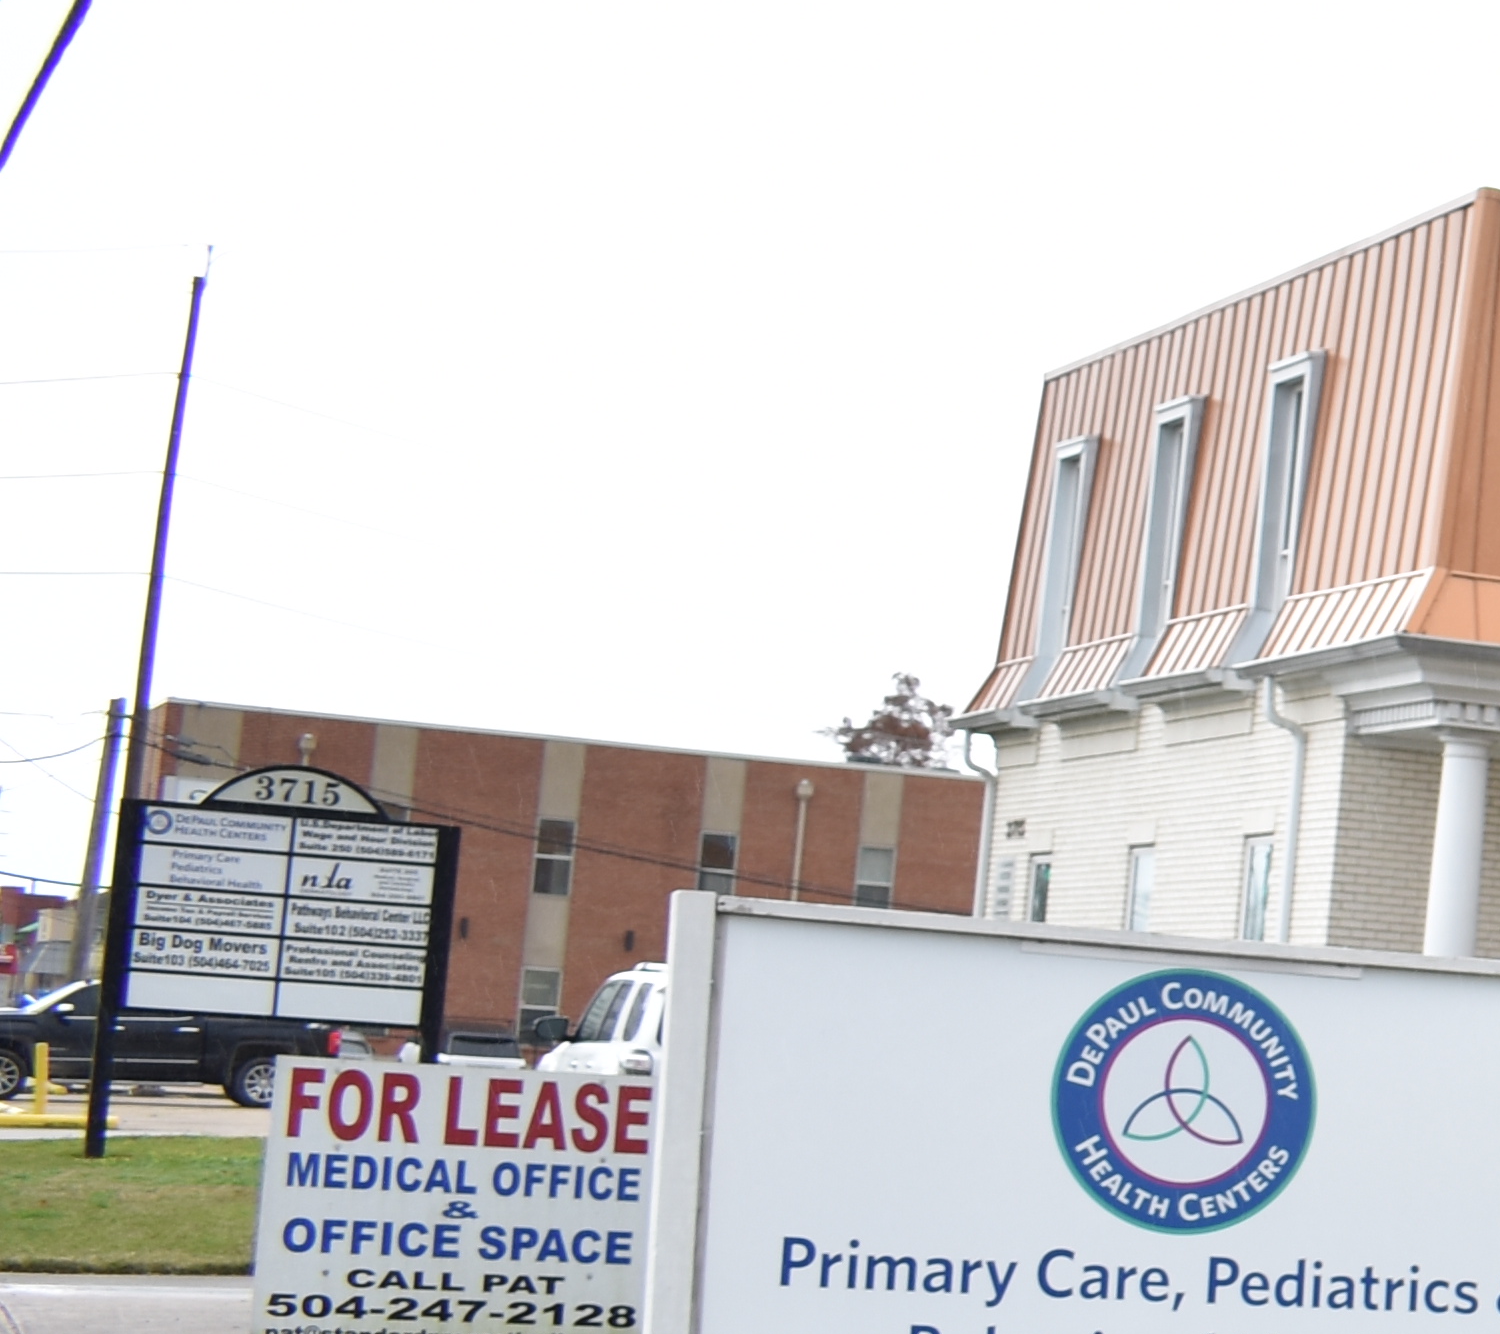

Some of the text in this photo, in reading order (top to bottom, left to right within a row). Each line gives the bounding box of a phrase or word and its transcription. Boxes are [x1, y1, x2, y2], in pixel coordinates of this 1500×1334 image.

[255, 776, 341, 806] 3715
[219, 829, 268, 841] CENTERS
[220, 818, 287, 831] COMMUNITY
[172, 849, 241, 863] Primary Care
[227, 879, 263, 890] Health
[198, 894, 274, 907] Associates
[139, 932, 268, 955] Big Dog Movers
[1161, 982, 1299, 1101] COMMUNITY
[286, 1067, 653, 1155] FOR LEASE
[286, 1152, 641, 1202] MEDICAL OFFICE
[1075, 1135, 1290, 1222] HEALTH CENTERS
[442, 1201, 478, 1219] &
[282, 1217, 633, 1265] OFFICE SPACE
[346, 1269, 566, 1295] CALL PAT
[778, 1236, 1018, 1307] Primary
[1035, 1247, 1187, 1310] Care,
[1206, 1254, 1480, 1316] Pediatrics
[266, 1293, 637, 1328] 504-247-2128
